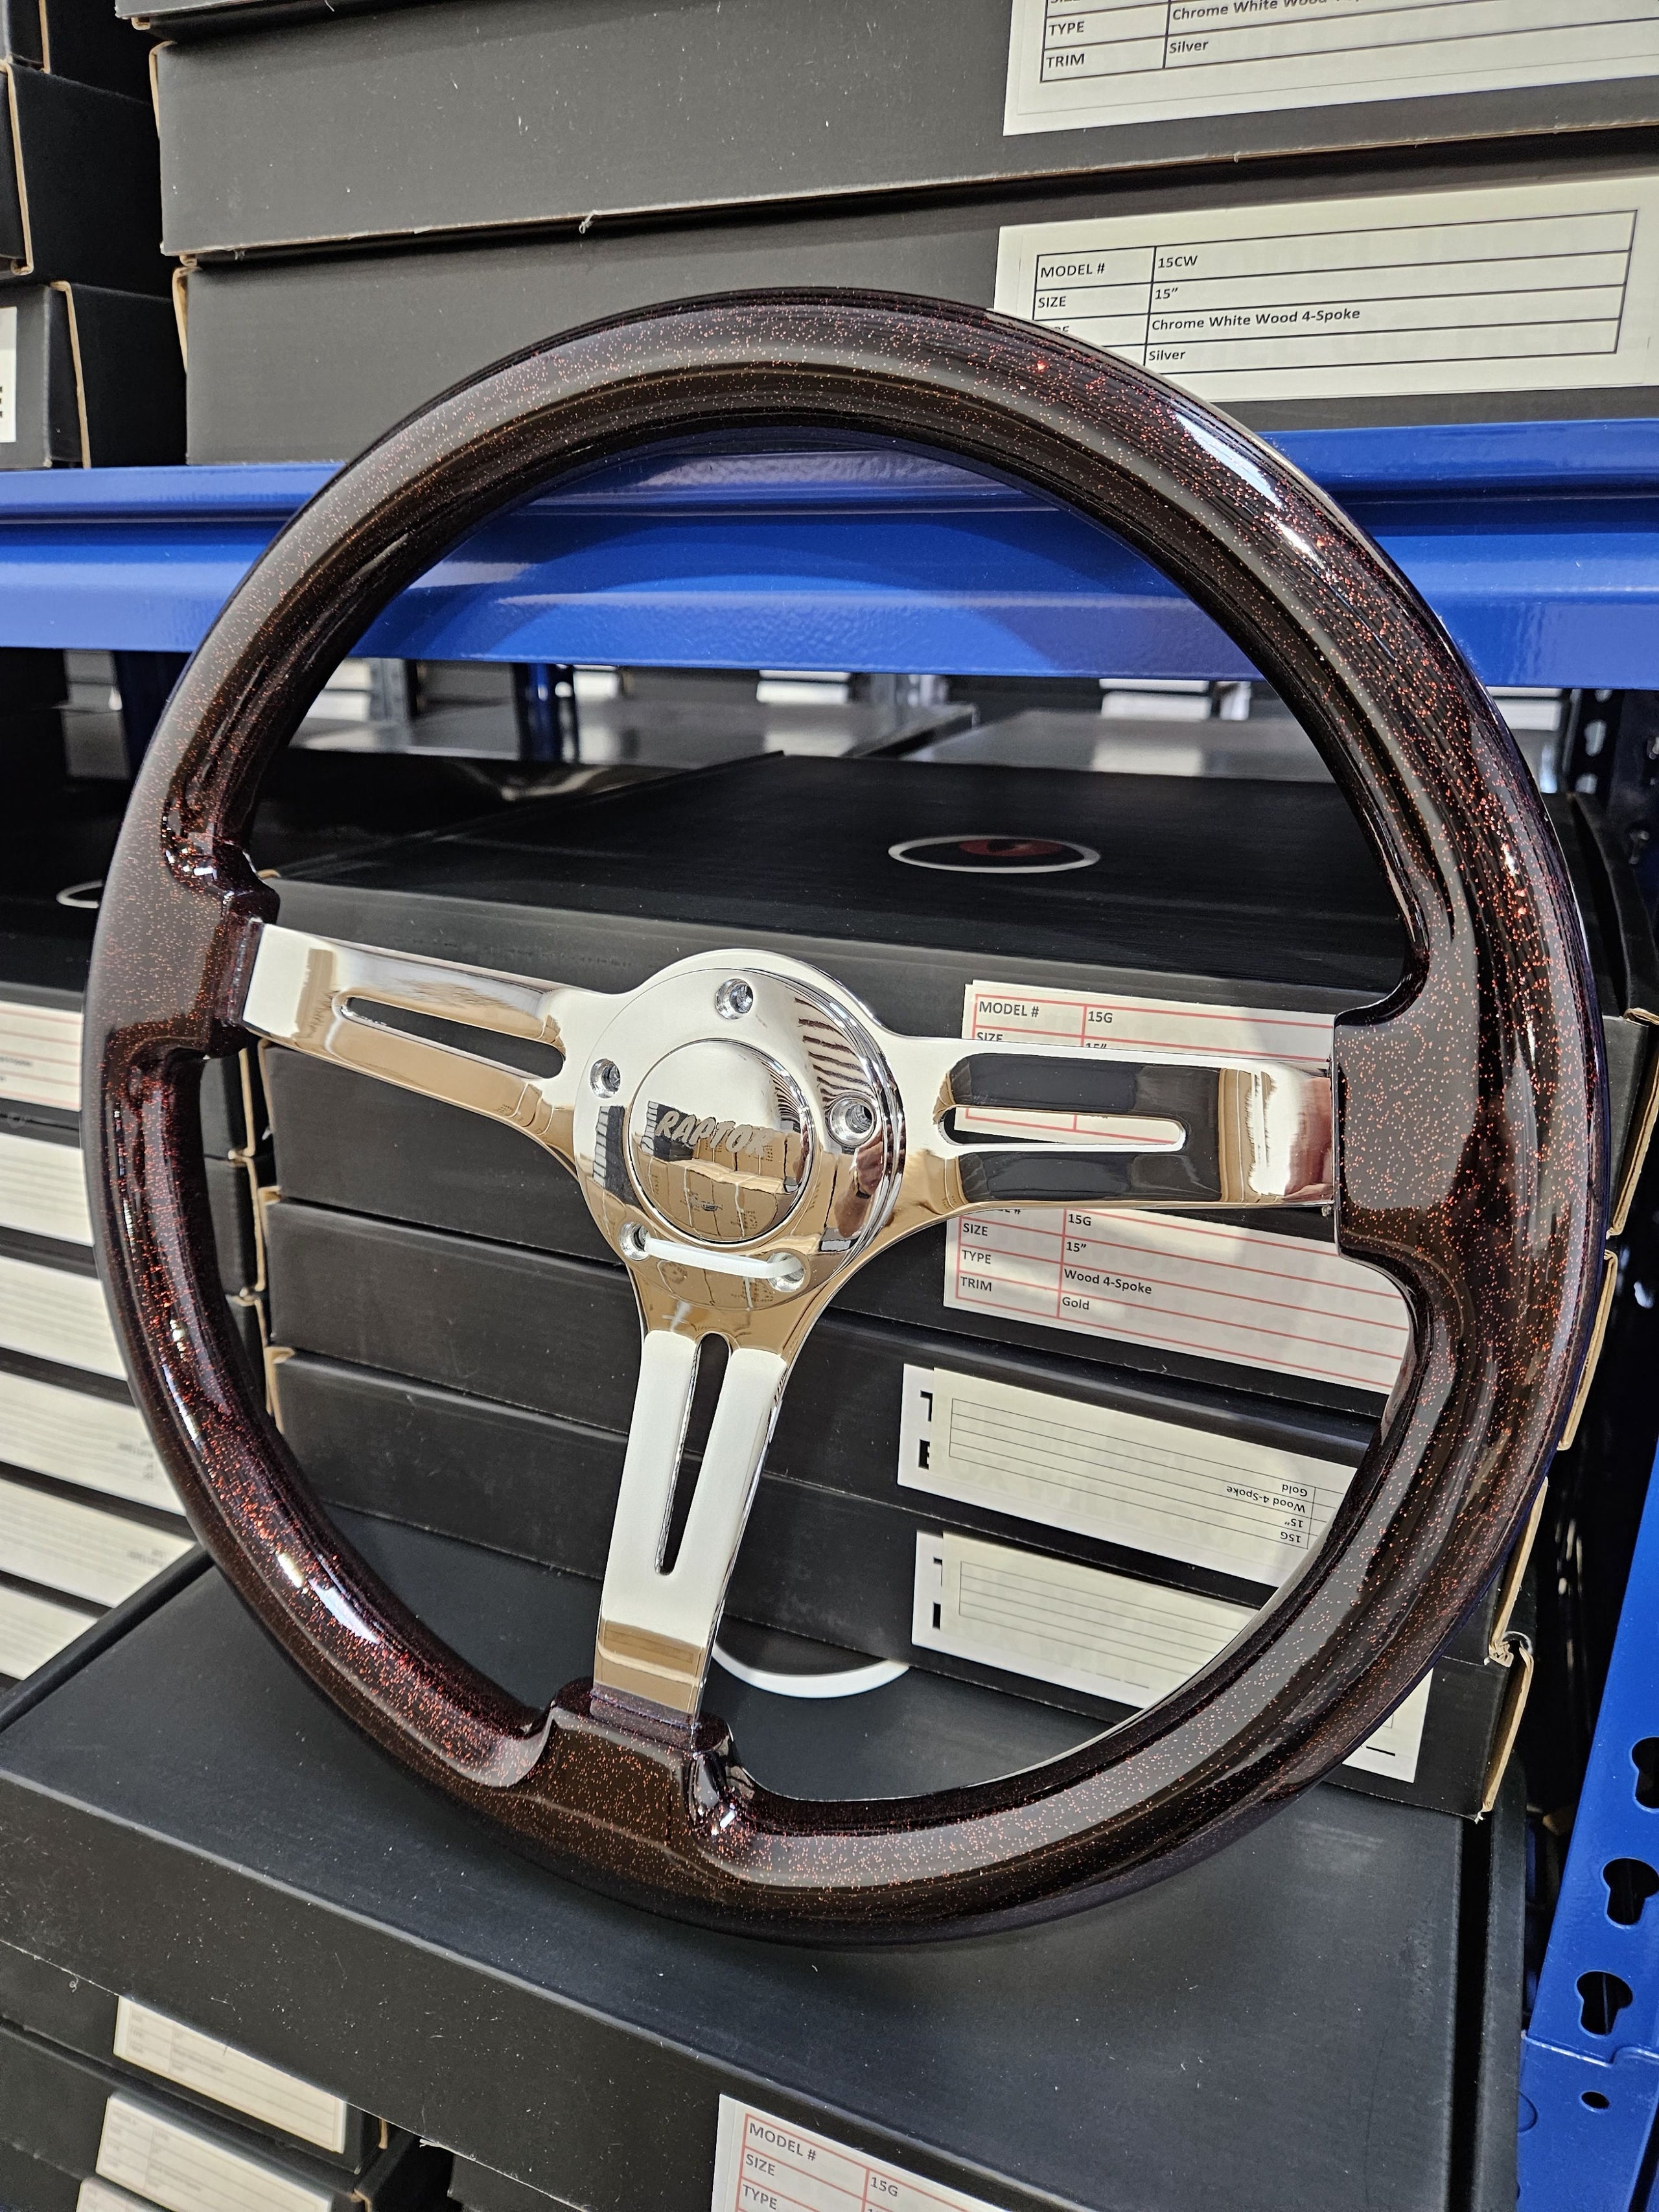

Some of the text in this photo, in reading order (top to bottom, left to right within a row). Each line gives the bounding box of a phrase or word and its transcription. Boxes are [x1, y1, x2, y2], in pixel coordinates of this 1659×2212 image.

[1172, 4, 1229, 21] Chrome
[1233, 0, 1279, 14] White
[1049, 21, 1085, 36] TYPE
[1169, 39, 1209, 54] Silver
[1046, 52, 1085, 68] TRIM
[1158, 255, 1198, 269] 15CW
[1040, 262, 1106, 279] MODEL #
[1038, 296, 1067, 309] SIZE
[1152, 308, 1361, 331] Chrome White Wood 4-Spoke
[1148, 349, 1186, 362] Silver
[979, 1001, 1039, 1018] MODEL #
[1087, 1010, 1113, 1023] 15G
[655, 1110, 774, 1156] RAPTOR
[1067, 1213, 1091, 1226] 15G
[962, 1222, 988, 1237] SIZE
[962, 1250, 992, 1264] TYPE
[960, 1276, 992, 1292] TRIM
[1064, 1268, 1152, 1295] Wood 4-Spoke
[1062, 1296, 1090, 1310] Gold
[1282, 1484, 1308, 1497] Gold
[1226, 1485, 1306, 1513] Wood 4-Spoke
[1280, 1531, 1302, 1543] 15G
[749, 2123, 817, 2161] MODEL #
[745, 2153, 776, 2176] SIZE
[870, 2176, 899, 2197] 15G
[743, 2183, 778, 2211] TYPE
